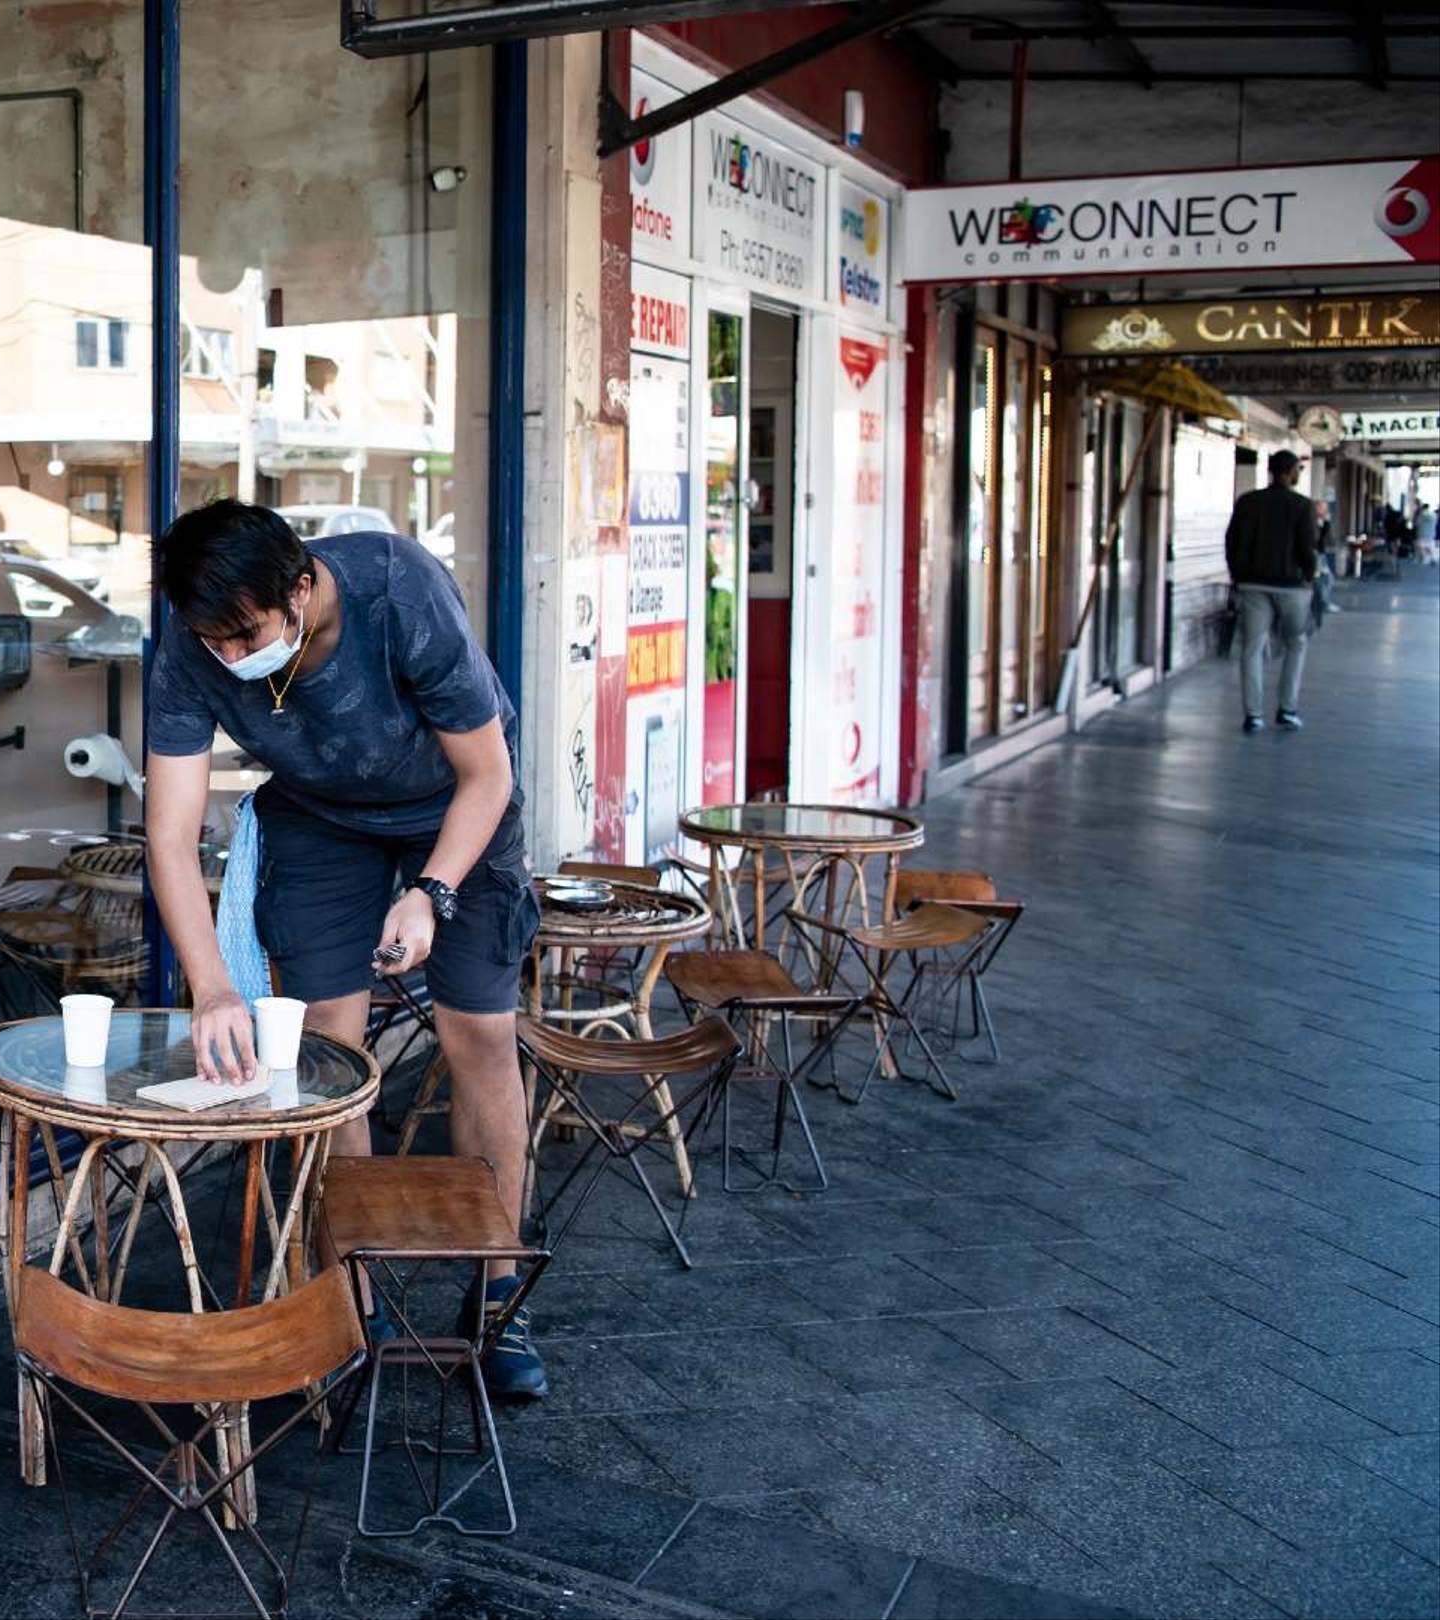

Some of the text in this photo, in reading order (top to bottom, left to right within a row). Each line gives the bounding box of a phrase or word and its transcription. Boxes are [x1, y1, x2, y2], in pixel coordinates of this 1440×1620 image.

[710, 129, 816, 219] WECONNECT
[949, 192, 1297, 247] WECONNECT
[964, 239, 1276, 266] communication
[640, 296, 688, 348] REPAIR
[1197, 297, 1422, 343] CANTIK
